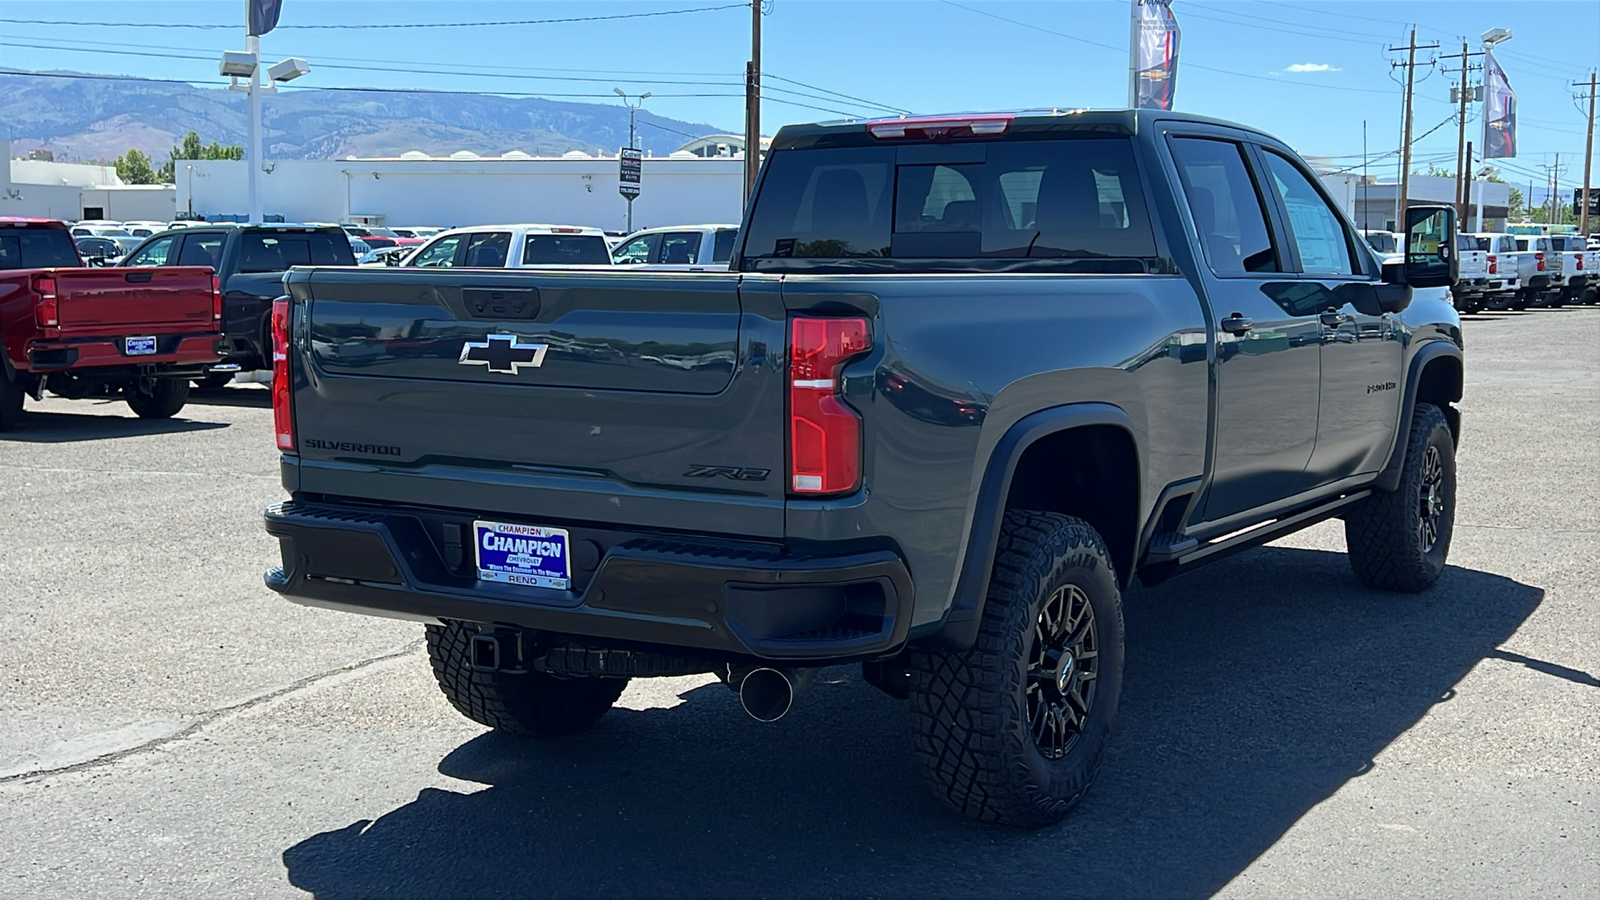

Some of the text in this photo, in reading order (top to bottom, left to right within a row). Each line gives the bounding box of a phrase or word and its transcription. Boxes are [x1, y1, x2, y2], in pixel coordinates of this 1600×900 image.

[305, 439, 401, 456] SILVERADO
[682, 464, 771, 481] ZR2
[498, 525, 542, 536] CHAMPION
[483, 532, 562, 557] CHAMPION
[508, 555, 540, 565] CHEVROLET
[508, 575, 537, 585] RENO
